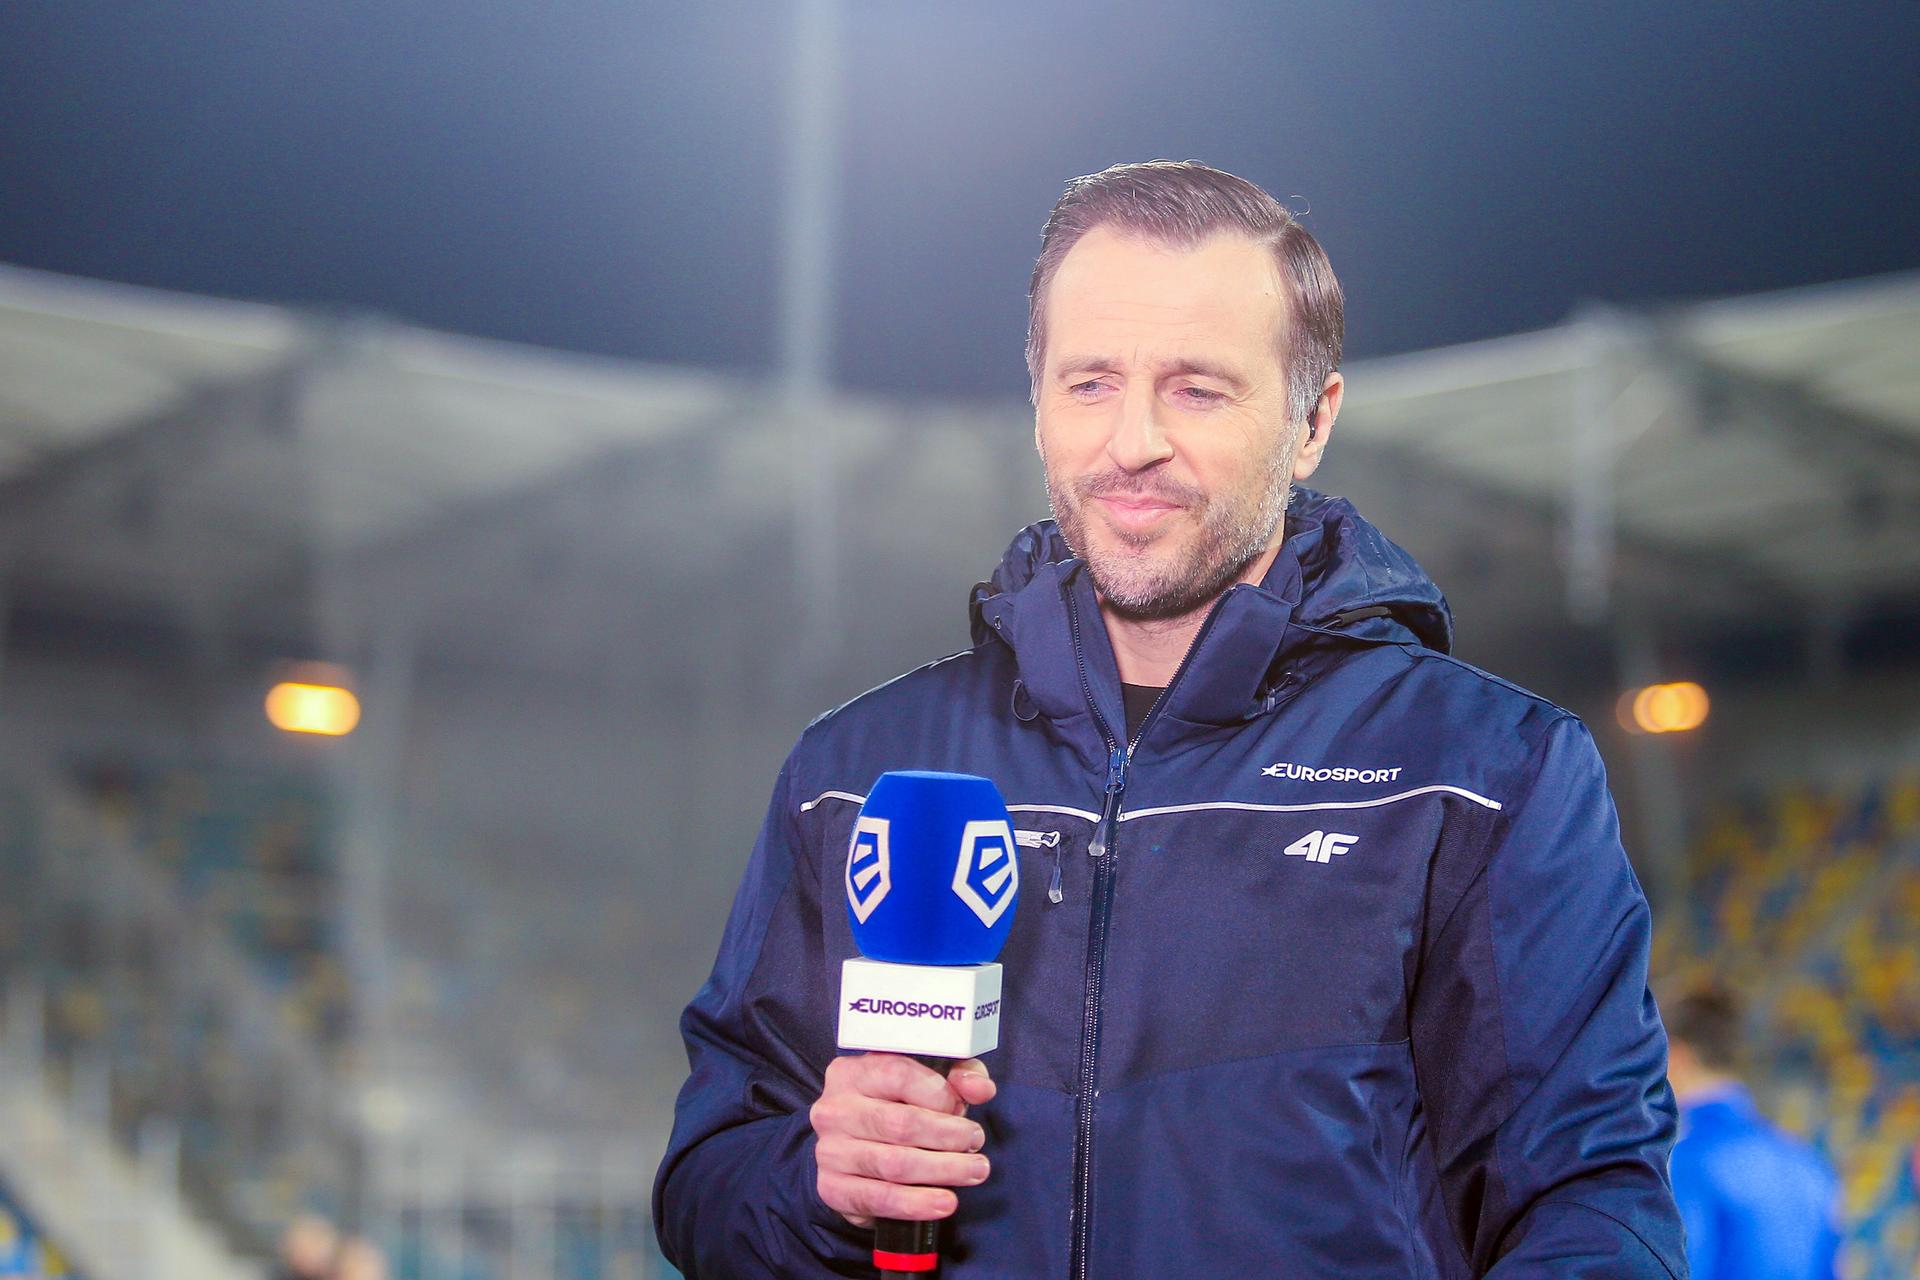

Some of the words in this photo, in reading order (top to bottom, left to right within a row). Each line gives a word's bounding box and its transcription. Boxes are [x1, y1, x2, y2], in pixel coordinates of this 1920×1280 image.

[1262, 762, 1402, 784] EUROSPORT
[1283, 830, 1360, 864] 4F
[848, 998, 966, 1021] EUROSPORT
